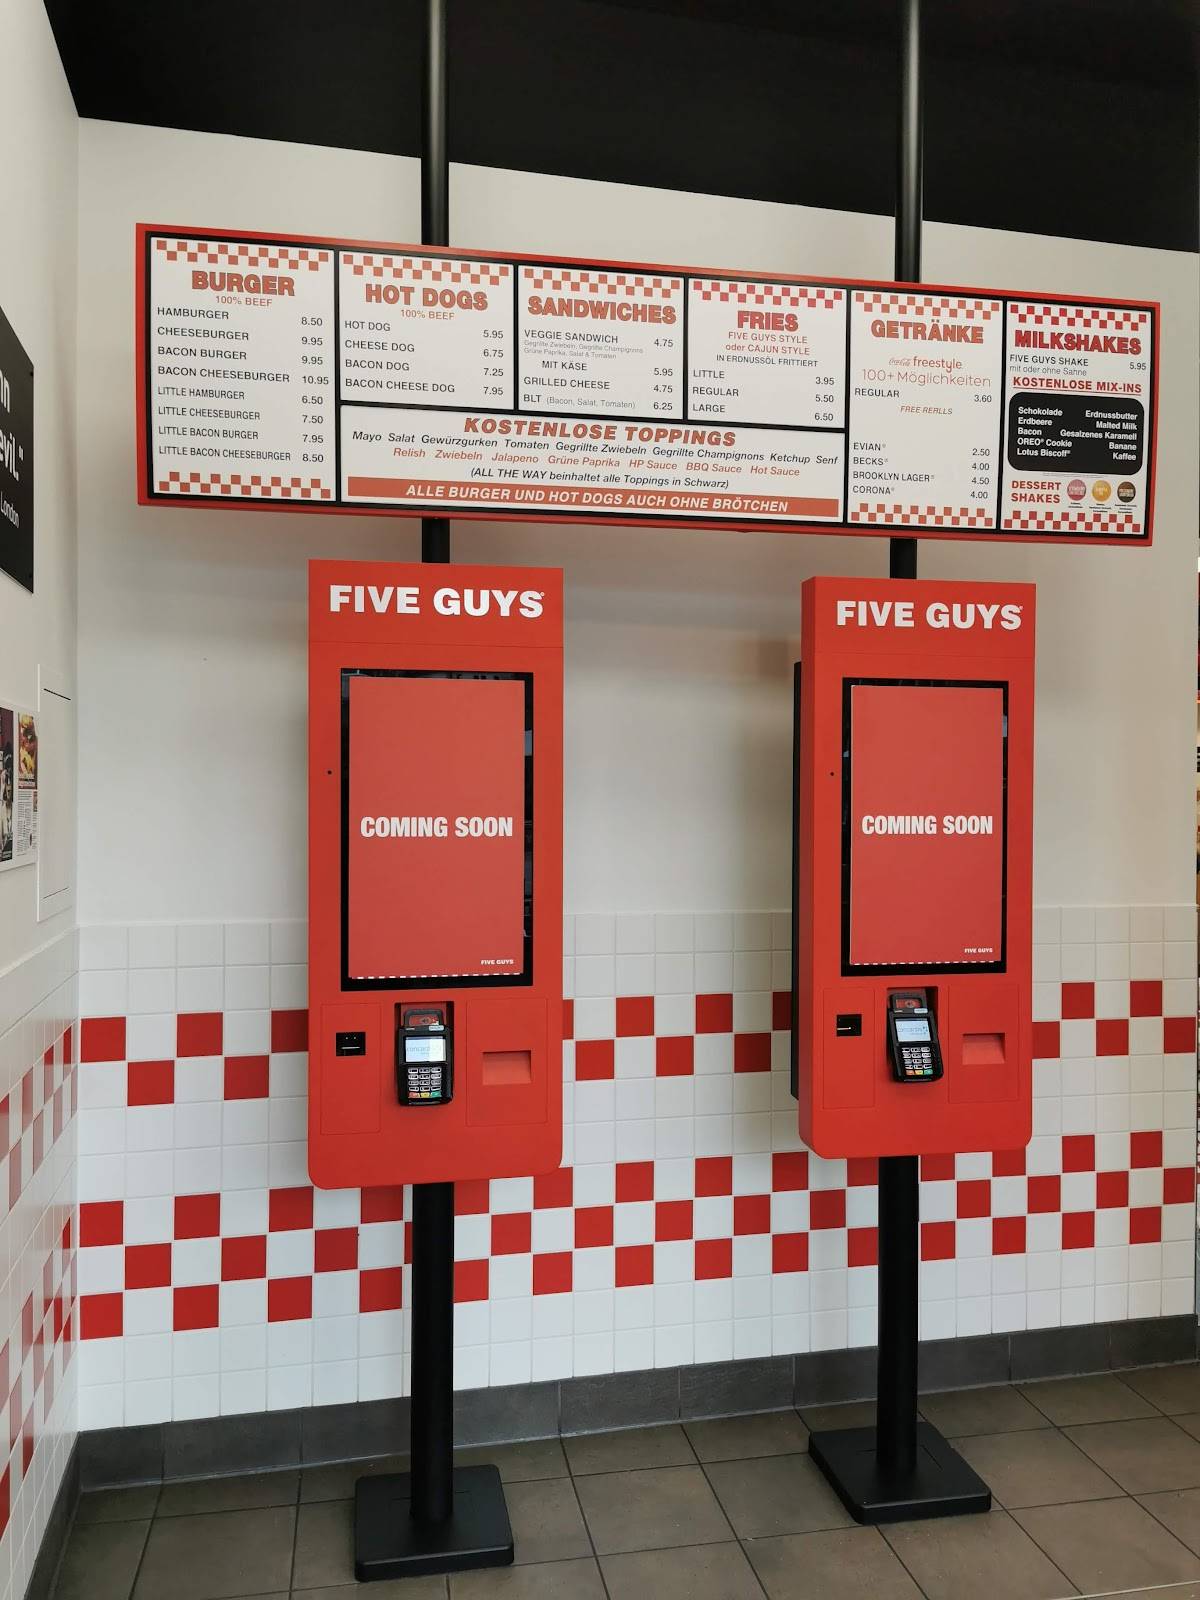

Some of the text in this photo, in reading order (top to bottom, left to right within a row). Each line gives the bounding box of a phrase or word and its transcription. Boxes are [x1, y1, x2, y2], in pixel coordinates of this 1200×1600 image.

[192, 270, 295, 296] BURGER
[216, 296, 272, 307] 100% BEEF
[365, 283, 488, 311] HOT DOGS
[157, 307, 322, 326] HAMBURGER 8.50
[400, 309, 454, 320] 100% BEEF
[528, 296, 676, 324] SANDWICHES
[345, 320, 503, 339] HOT DOG 5.95
[737, 310, 798, 332] FRIES
[157, 326, 323, 346] CHEESEBURGER 9.95
[524, 330, 561, 339] VEGGIE
[565, 332, 618, 343] SANDWICH
[654, 338, 673, 347] 4.75
[728, 331, 807, 344] FIVE GUYS STYLE
[871, 319, 984, 344] GETRÄNKE
[345, 339, 504, 358] CHEESE DOG 6.75
[726, 343, 810, 356] oder CAJUN STYLE
[1014, 329, 1142, 355] MILKSHAKES
[158, 346, 323, 365] BACON BURGER 9.95
[778, 358, 818, 367] FRITTIERT
[913, 356, 962, 371] freestyle
[1010, 354, 1146, 370] FIVE GUYS SHAKE 5.95
[158, 366, 329, 385] BACON CHEESEBURGER 10.95
[345, 359, 504, 376] BACON DOG 7.25
[542, 360, 673, 376] MIT KÄSE 5.95
[524, 377, 672, 393] GRILLED CHEESE 4.75
[693, 369, 834, 385] LITTLE 3.95
[863, 369, 991, 387] 100+ Möglichkeiten
[1013, 377, 1142, 393] KOSTENLOSE MIX-INS
[345, 378, 503, 395] BACON CHEESE DOG 7.95
[693, 386, 834, 402] REGULAR 5.50
[854, 388, 899, 397] REGULAR
[158, 386, 323, 405] LITTLE HAMBURGER 6.50
[523, 393, 672, 410] BLT 6.25
[158, 406, 324, 424] LITTLE CHEESEBURGER 7.50
[693, 403, 833, 421] LARGE 6.50
[1018, 406, 1063, 416] Schokolade
[1085, 410, 1138, 420] Erdnussbutter
[158, 426, 324, 443] LITTLE BACON BURGER 7.95
[464, 417, 736, 446] KOSTENLOSE TOPPINGS
[1018, 427, 1042, 435] Bacon
[1122, 422, 1137, 430] Milk
[352, 431, 838, 464] Mayo Salat Gewürzgurken Tomaten Gegrillte Zwiebeln Gegrillte Champignons Ketchup Senf
[1046, 438, 1072, 447] Cookie
[1109, 442, 1137, 450] Banane
[159, 446, 324, 462] LITTLE BACON CHEESEBURGER 8.50
[972, 448, 990, 456] 2.50
[1017, 448, 1038, 456] Lotus
[1112, 452, 1136, 460] Kaffee
[393, 447, 800, 476] Relish Zwiebeln Grüne Paprika HP Sauce BBQ Sauce Hot Sauce
[972, 462, 990, 470] 4.00
[471, 468, 728, 489] (ALL THE WAY beinhaltet alle Toppings Schwarz)
[853, 471, 990, 485] BROOKLYN 4.50
[1012, 480, 1061, 490] DESSERT
[406, 485, 788, 512] ALLE BURGER UND HOT DOGS AUCH OHNE BRÖTCHEN
[970, 491, 988, 499] 4.00
[1011, 492, 1060, 503] SHAKES
[0, 491, 20, 528] London
[330, 585, 420, 614] FIVE
[837, 600, 914, 627] FIVE
[360, 816, 513, 838] COMING SOON
[862, 815, 993, 835] COMING SOON
